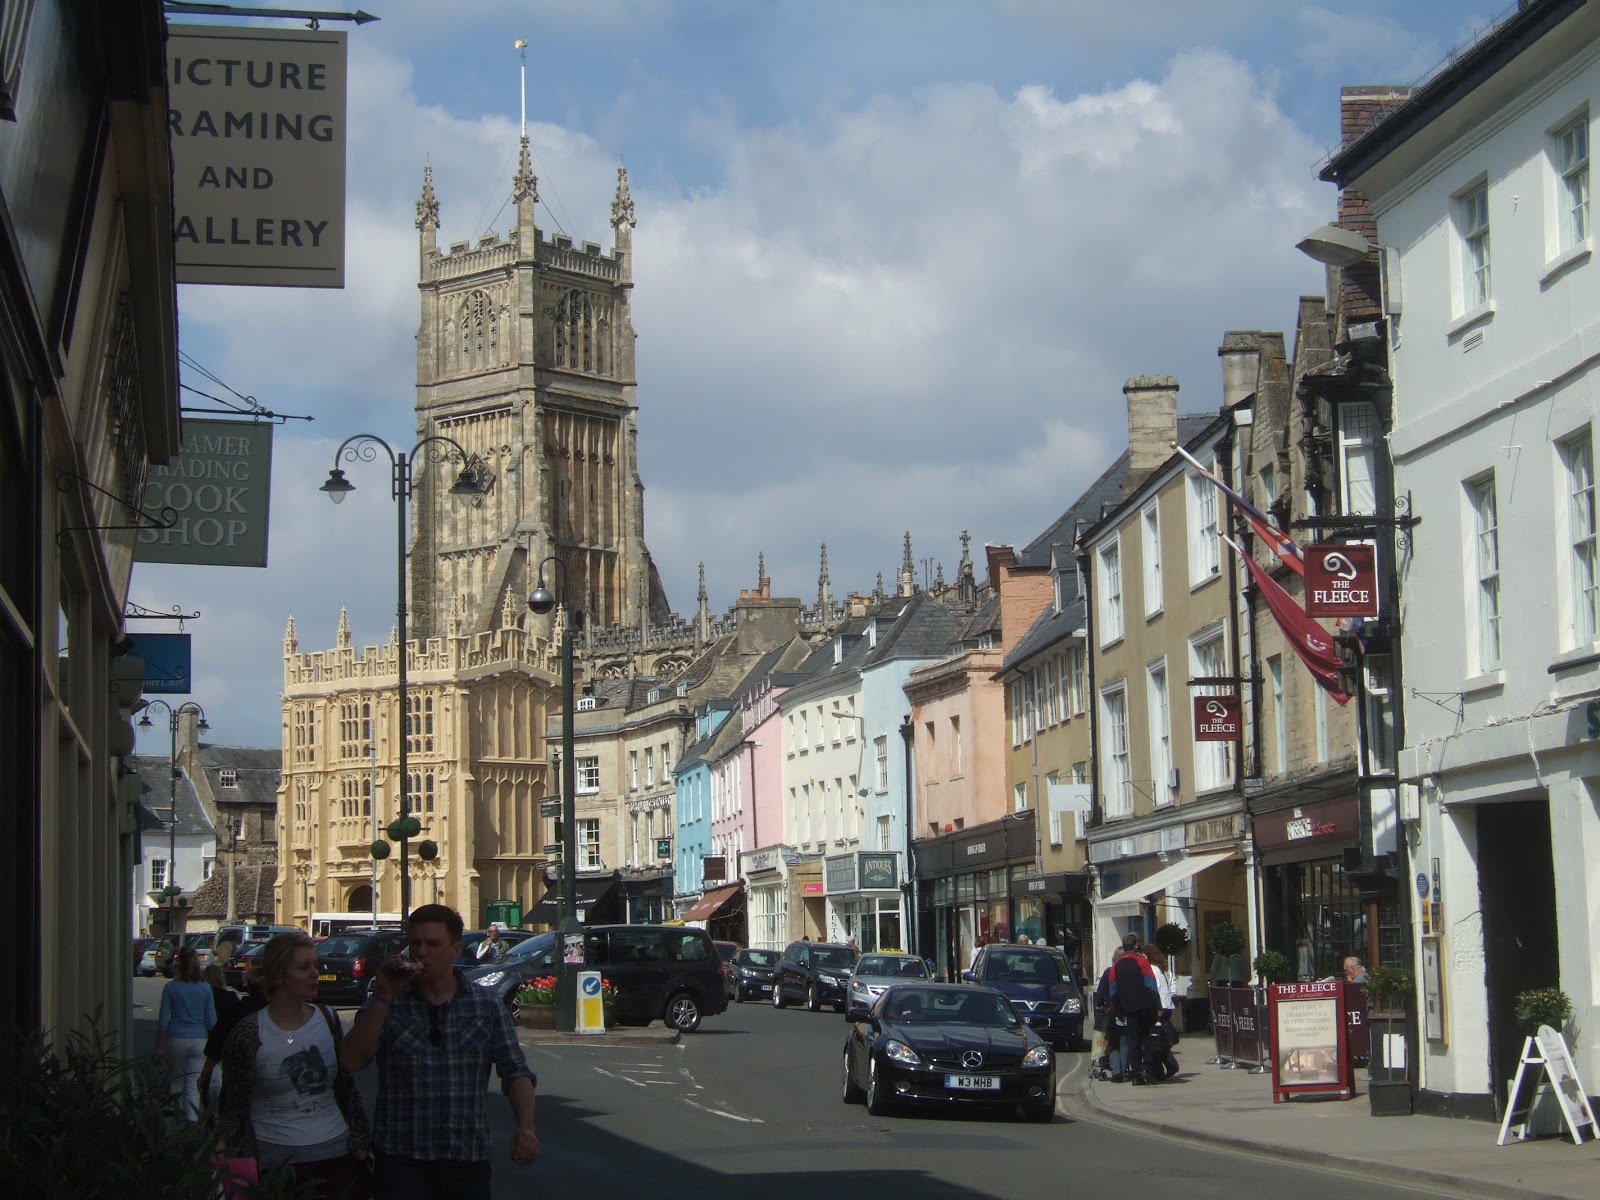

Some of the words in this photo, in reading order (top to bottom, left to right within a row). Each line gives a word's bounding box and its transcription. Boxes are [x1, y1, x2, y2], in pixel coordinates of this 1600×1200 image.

[174, 57, 327, 91] ICTURE
[169, 109, 334, 142] RAMING
[198, 165, 274, 190] AND
[174, 215, 329, 248] ALLERY
[180, 435, 251, 456] AMER
[143, 482, 249, 514] COOK
[138, 515, 248, 547] SHOP
[1331, 580, 1350, 589] THE
[1313, 590, 1370, 604] FLEECE
[1199, 724, 1236, 733] FLEECE
[864, 860, 892, 875] ANTIQUES
[831, 908, 839, 943] RESTA
[1277, 985, 1297, 994] THE
[1300, 982, 1337, 993] FLEECE
[958, 1077, 971, 1087] W3
[973, 1077, 993, 1088] MHB
